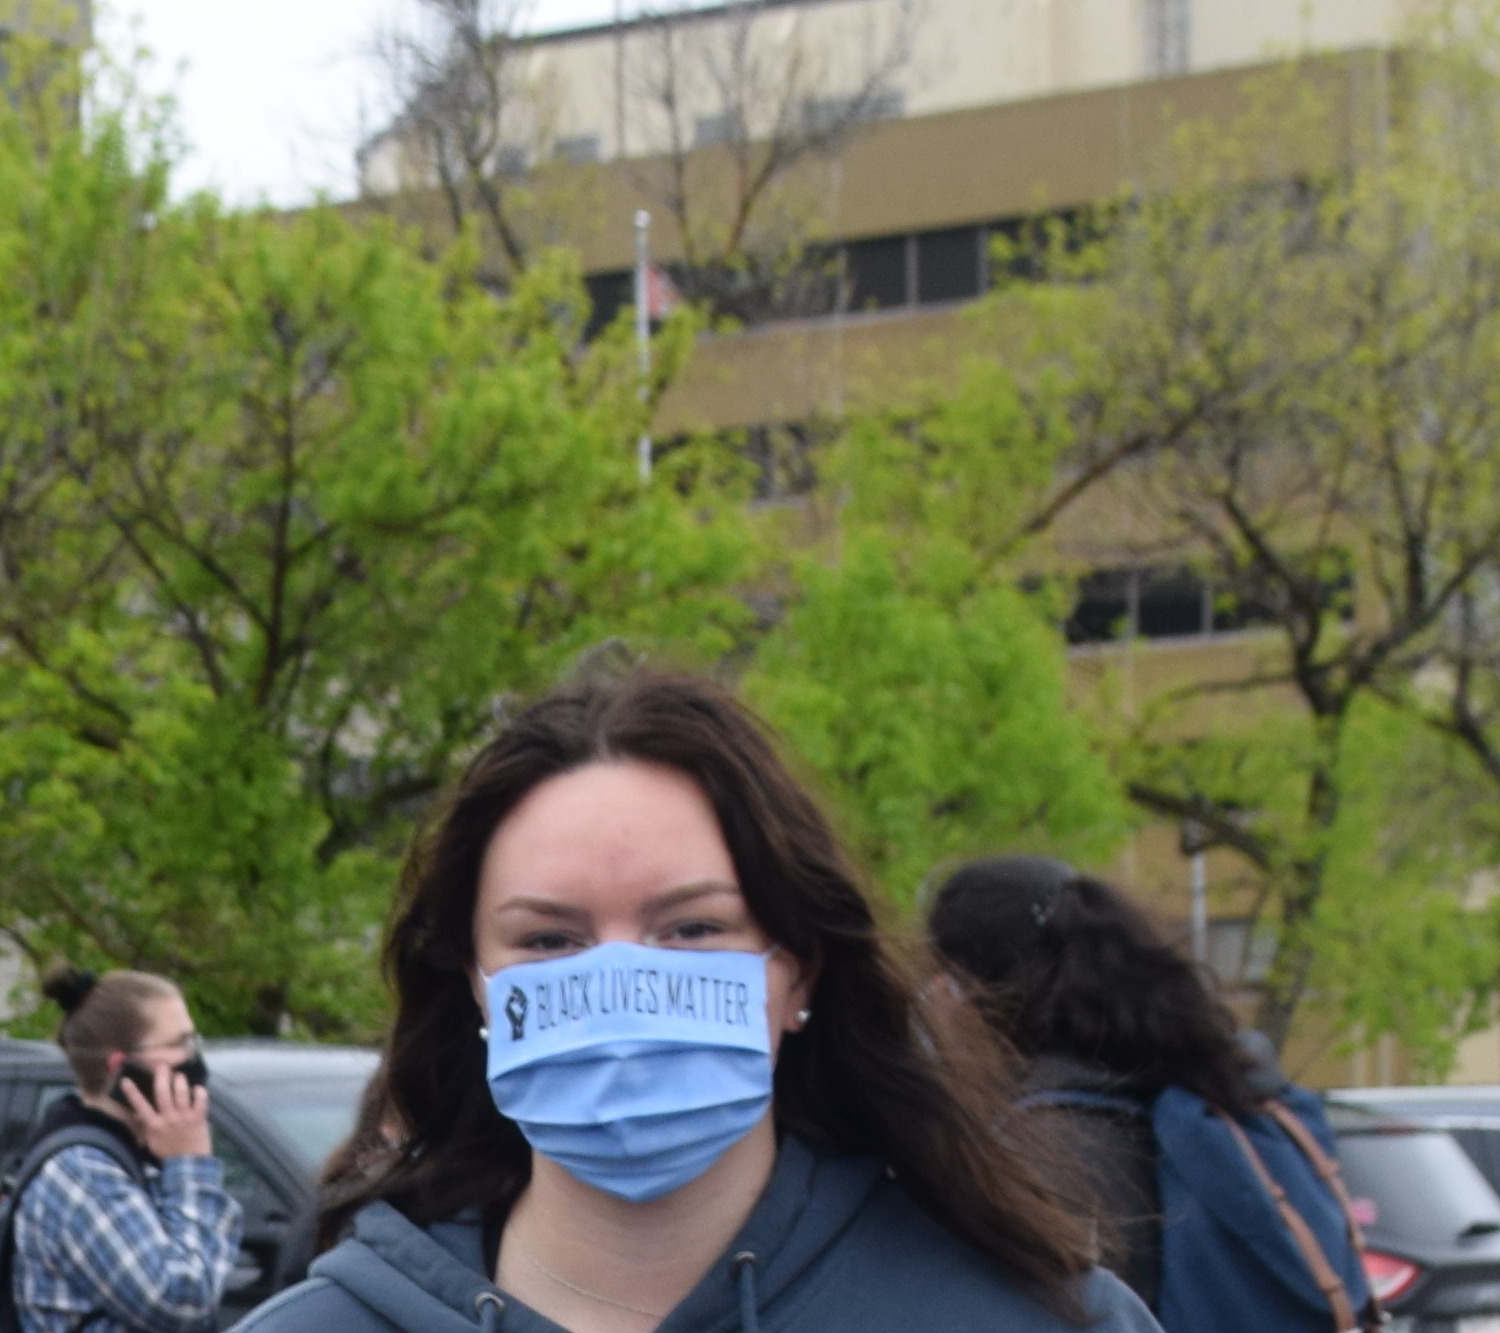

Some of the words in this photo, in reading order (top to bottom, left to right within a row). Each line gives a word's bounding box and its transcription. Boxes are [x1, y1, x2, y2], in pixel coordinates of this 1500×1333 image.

[535, 971, 593, 1031] BLACK
[600, 965, 660, 1015] LIVES
[666, 971, 750, 1027] MATTER
